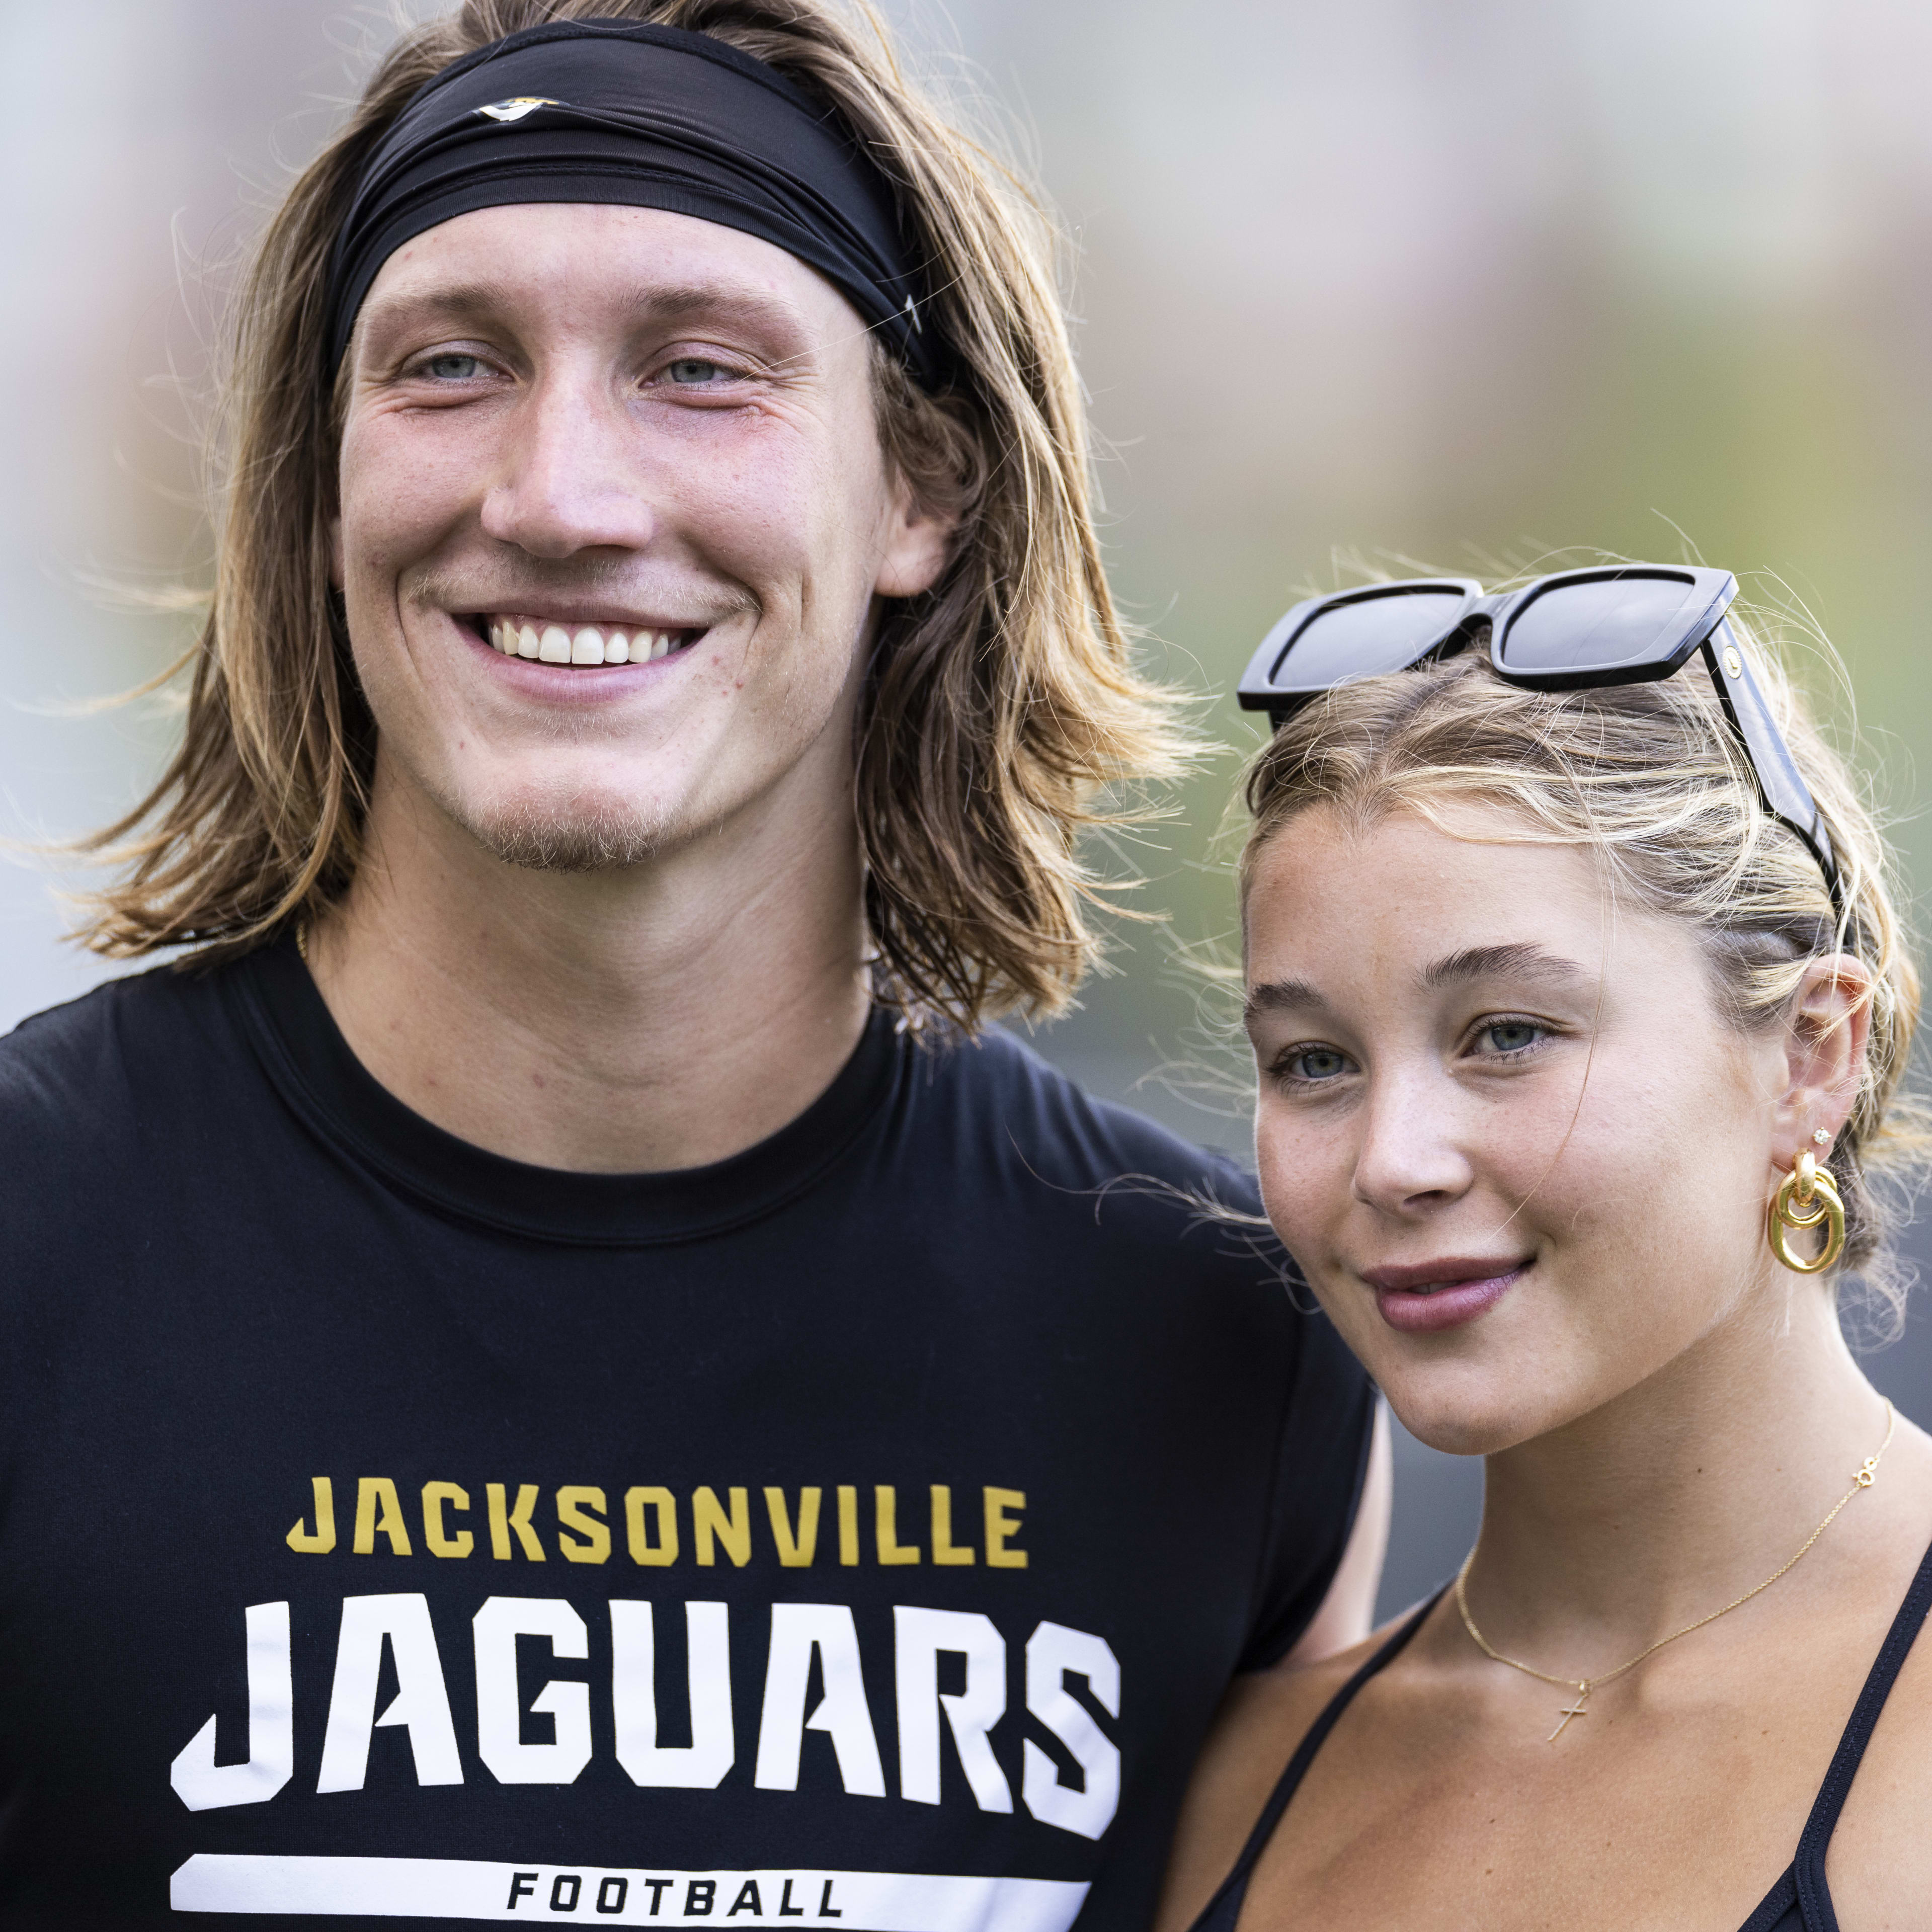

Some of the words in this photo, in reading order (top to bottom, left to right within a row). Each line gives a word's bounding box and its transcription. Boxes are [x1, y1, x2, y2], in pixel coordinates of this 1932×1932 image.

[285, 1476, 1028, 1569] JACKSONVILLE
[170, 1592, 1121, 1841] JAGUARS
[506, 1872, 843, 1918] FOOTBALL
